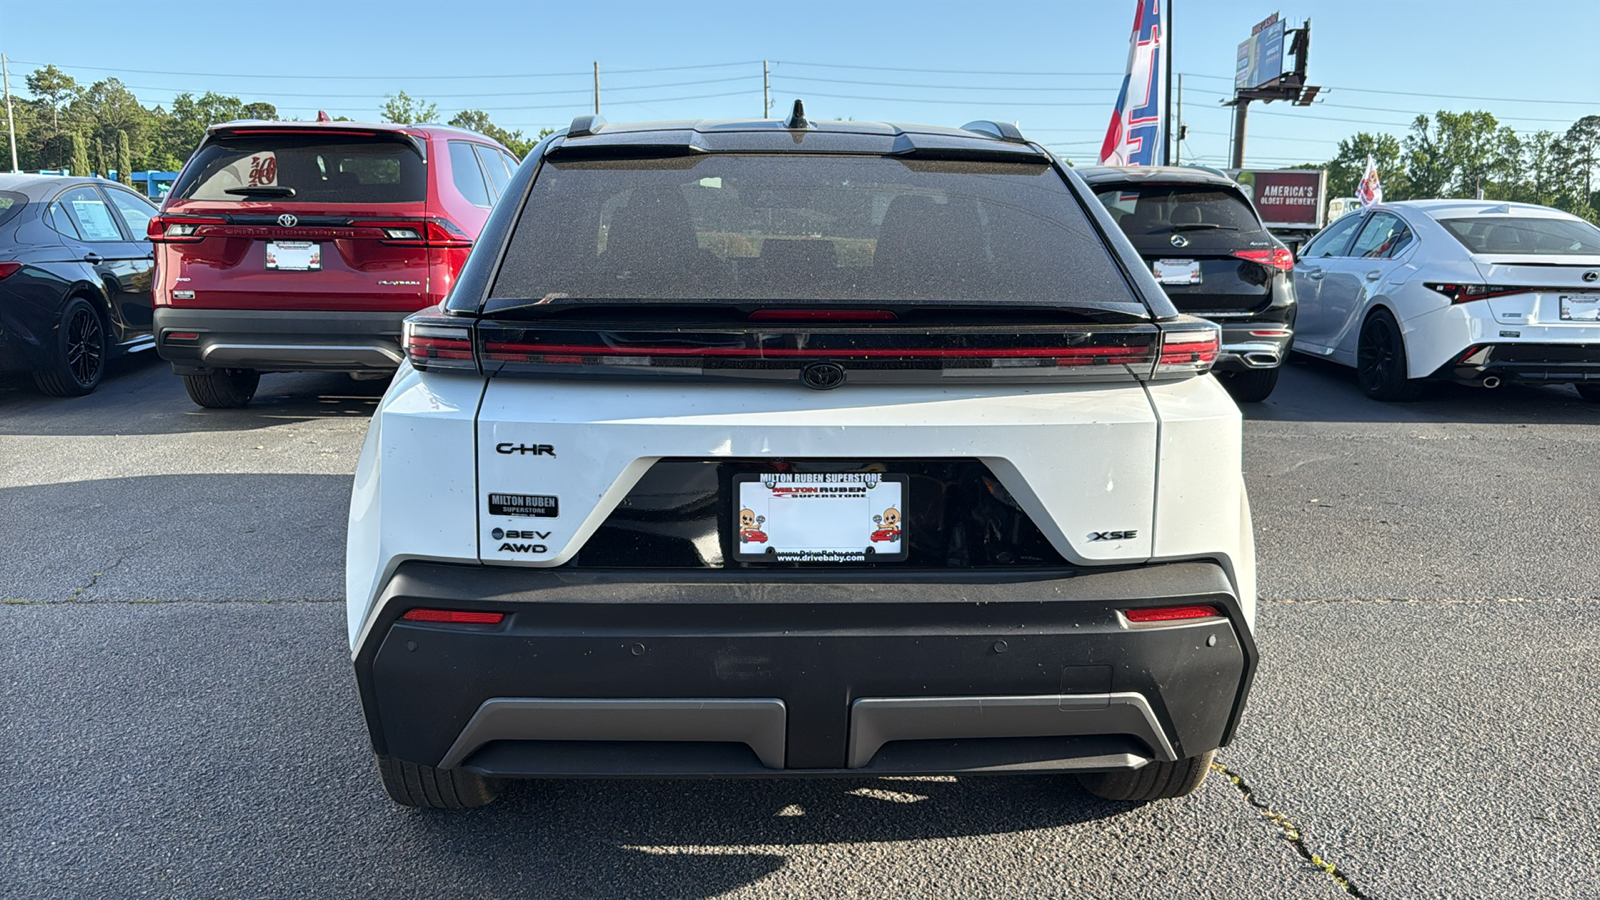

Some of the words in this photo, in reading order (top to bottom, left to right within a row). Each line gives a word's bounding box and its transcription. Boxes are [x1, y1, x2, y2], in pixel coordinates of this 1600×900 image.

[1264, 186, 1313, 197] AMERICA'S
[1260, 196, 1284, 205] OLDEST
[760, 473, 794, 483] MILTON
[794, 473, 824, 483] RUBEN
[825, 473, 883, 483] SUPERSTORE
[491, 495, 524, 506] MILTON
[525, 496, 555, 508] RUBEN
[502, 506, 546, 514] SUPERSTORE
[505, 530, 552, 540] BEV
[1091, 530, 1138, 541] XSE
[498, 543, 548, 553] AWD
[777, 554, 865, 562] www.drivebaby.com
